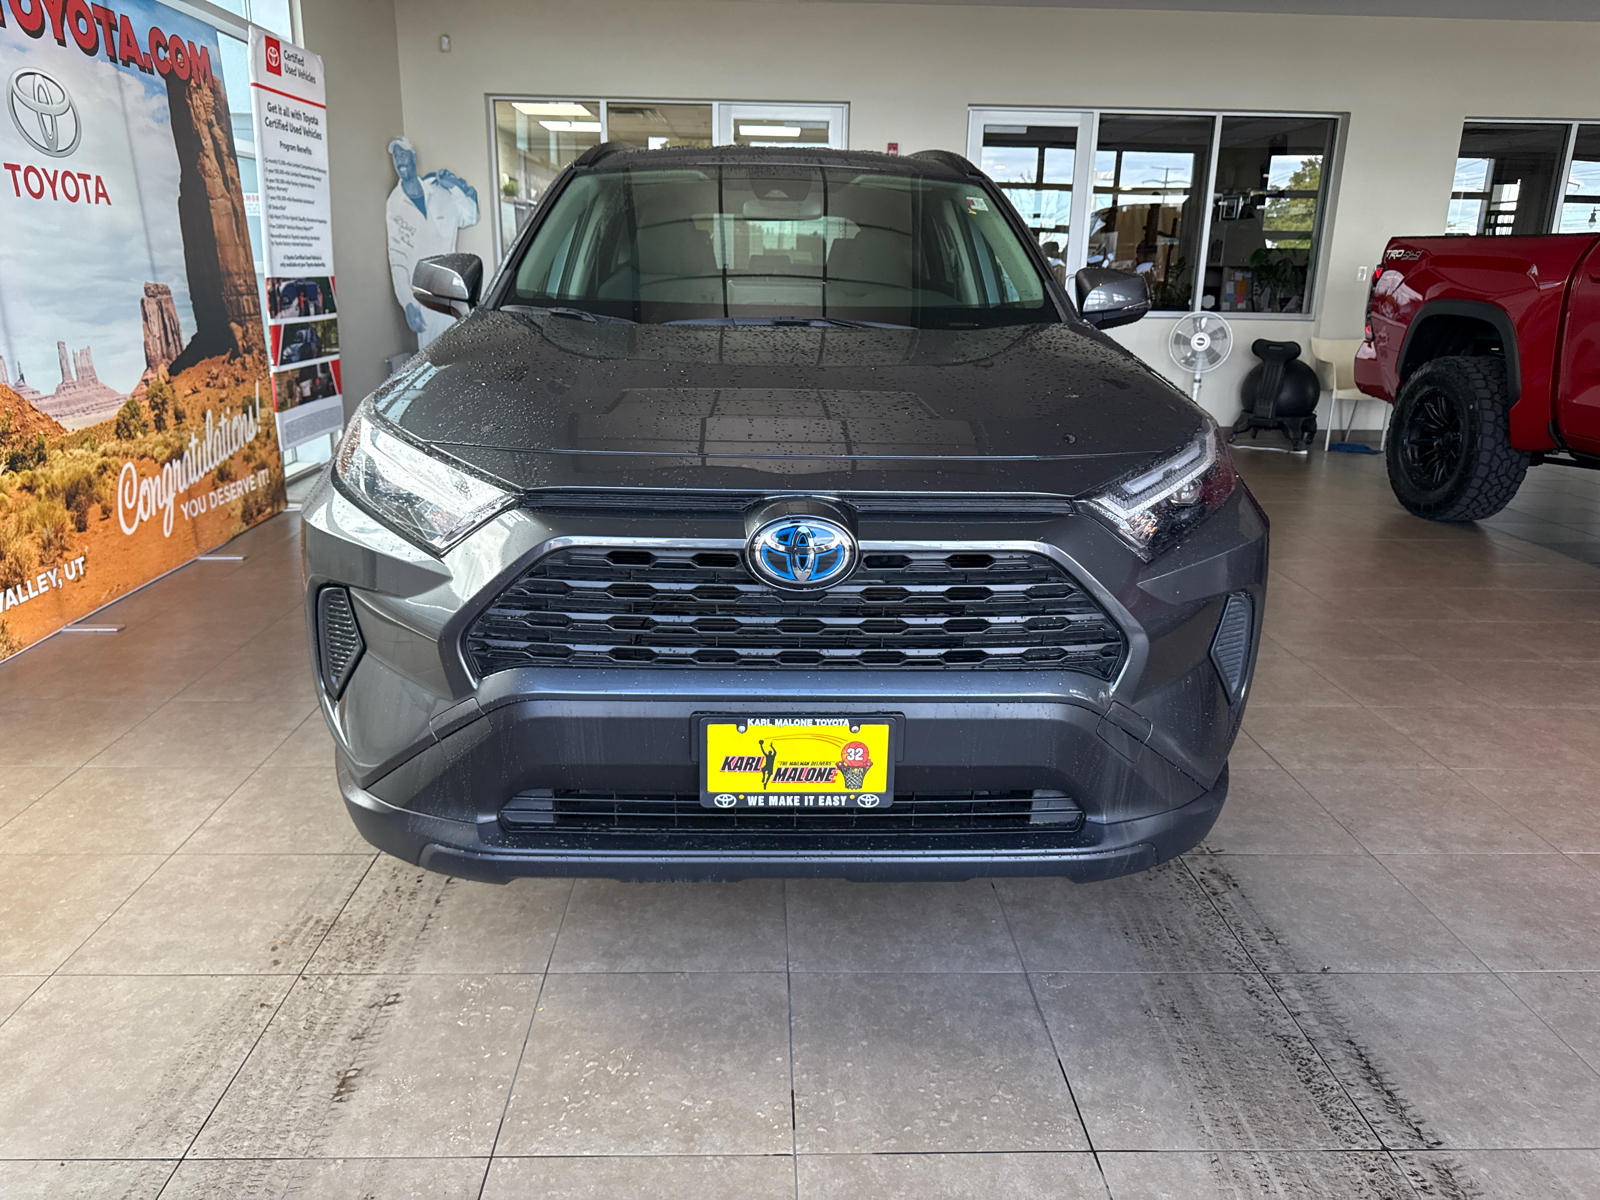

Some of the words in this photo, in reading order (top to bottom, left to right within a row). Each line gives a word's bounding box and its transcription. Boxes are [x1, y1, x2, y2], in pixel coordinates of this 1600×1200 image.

[0, 0, 214, 88] OYOTA.COM
[284, 50, 304, 66] Certified
[285, 63, 297, 77] Used
[298, 69, 316, 84] Vehicles
[267, 102, 277, 113] Get
[291, 109, 302, 121] with
[303, 112, 318, 126] Toyota
[265, 116, 288, 132] Certified
[290, 123, 302, 135] Used
[303, 127, 322, 140] Vehicles
[279, 141, 296, 152] Program
[297, 145, 312, 155] Benefits
[3, 162, 112, 206] TOYOTA
[118, 380, 262, 538] Congratulations!
[180, 500, 207, 521] YOU
[209, 479, 256, 509] DESERVE
[257, 468, 271, 489] IT!
[64, 556, 85, 581] UT
[747, 718, 772, 727] KARL
[775, 718, 813, 727] MALONE
[814, 718, 850, 727] TOYOTA
[720, 756, 764, 772] KARL
[846, 748, 864, 761] 32
[772, 767, 837, 783] MALONE
[747, 796, 765, 806] WE
[768, 796, 800, 806] MAKE
[804, 796, 814, 806] IT
[818, 796, 847, 806] EASY
